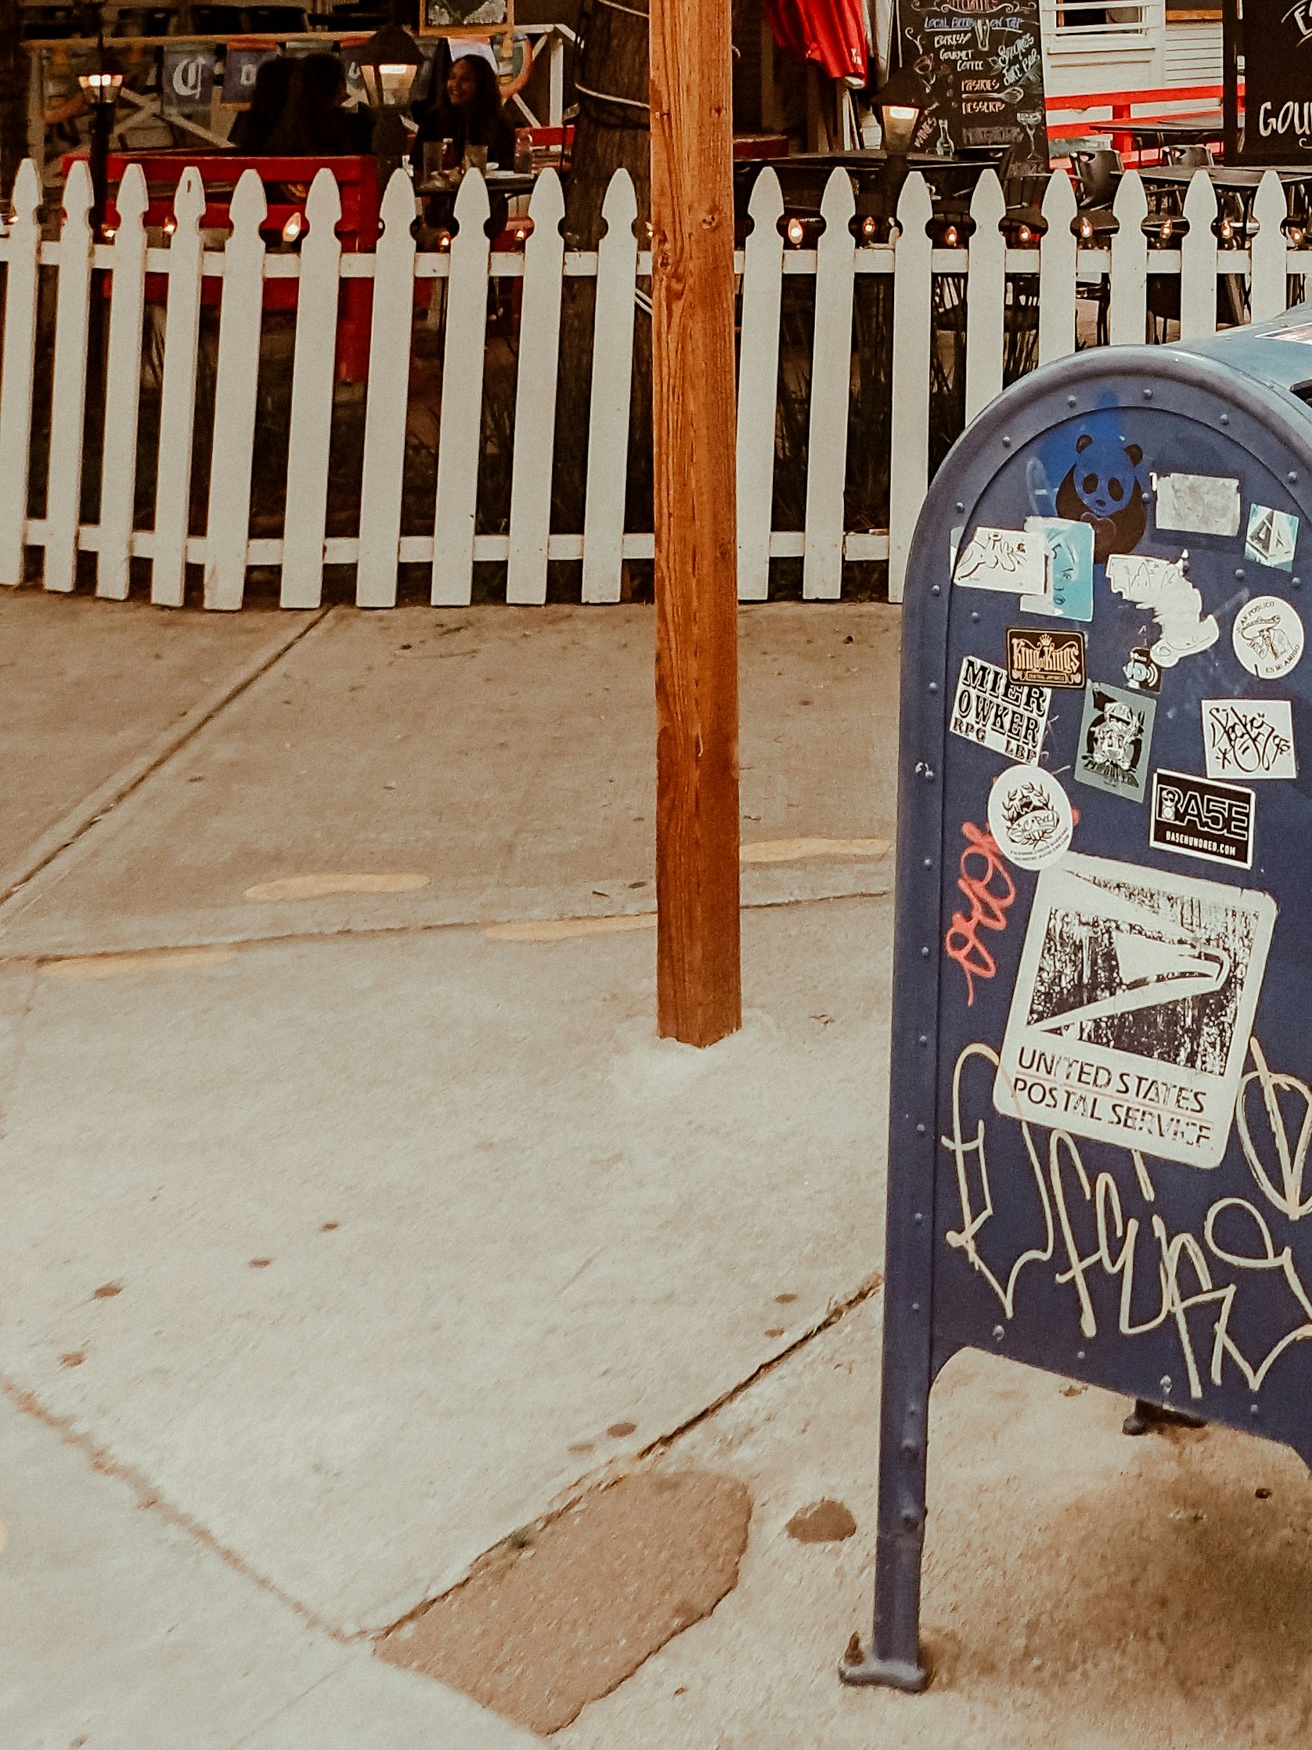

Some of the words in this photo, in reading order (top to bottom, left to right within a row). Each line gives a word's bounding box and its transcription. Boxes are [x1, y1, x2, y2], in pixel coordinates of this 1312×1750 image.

[1012, 637, 1041, 672] King
[1044, 644, 1081, 674] Kings
[963, 659, 1047, 718] MIER
[953, 716, 988, 743] RPG
[957, 689, 1041, 751] OWKER
[1013, 1077, 1103, 1123] POSTAL
[1017, 1045, 1114, 1090] UNITED
[1116, 1072, 1207, 1115] STATES
